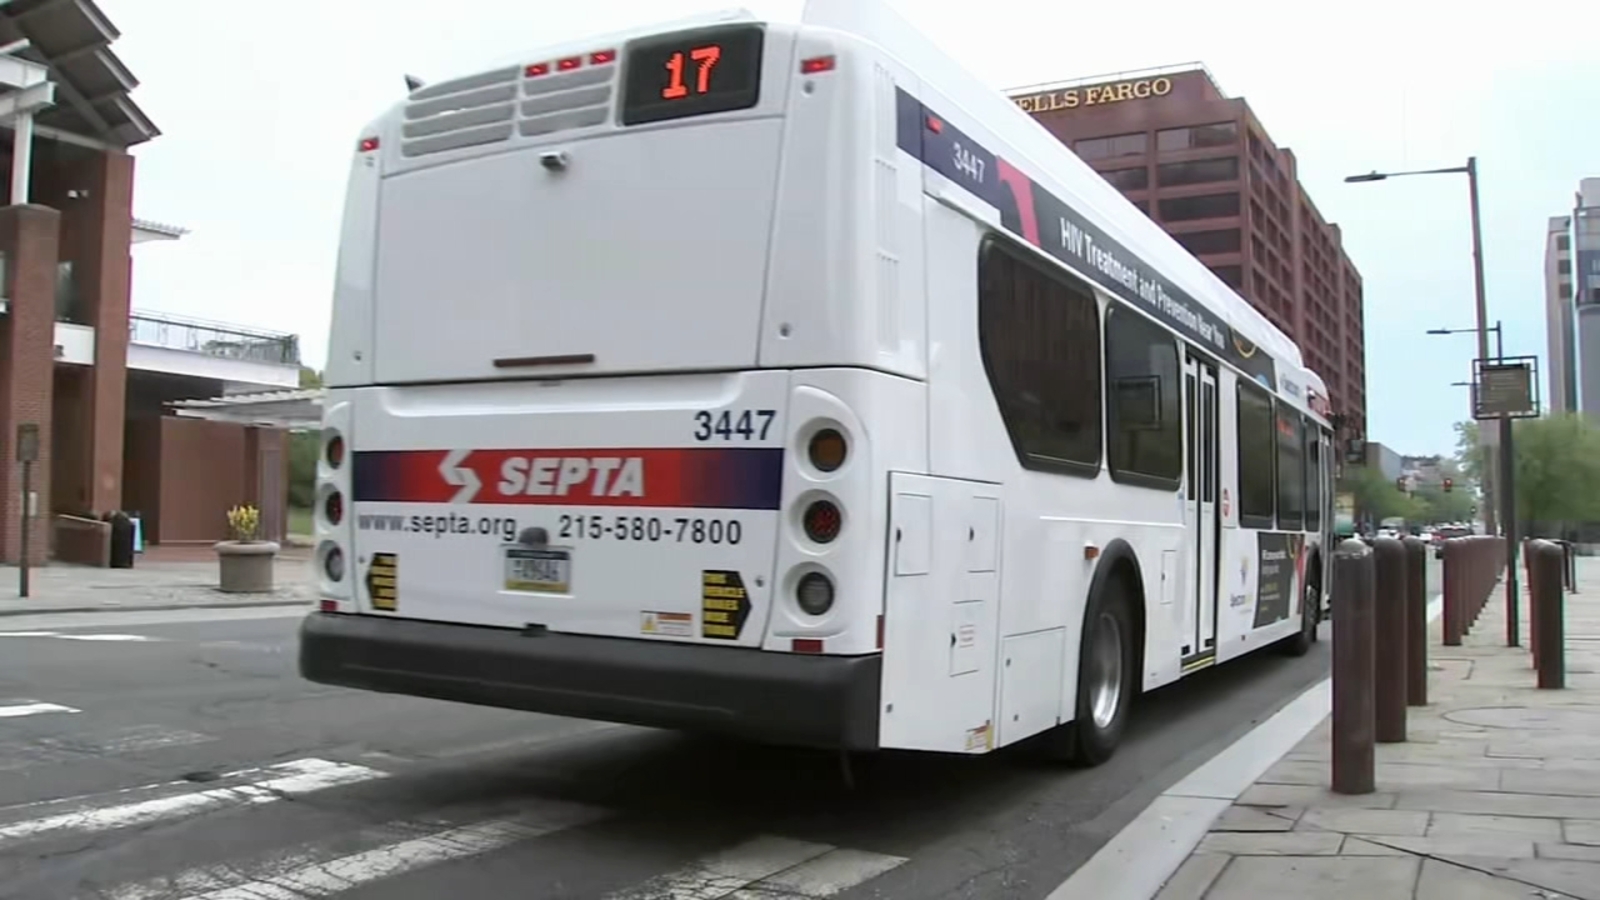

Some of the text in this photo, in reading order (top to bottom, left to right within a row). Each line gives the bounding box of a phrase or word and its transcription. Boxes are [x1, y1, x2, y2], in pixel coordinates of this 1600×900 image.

[662, 45, 721, 99] 17
[1014, 78, 1172, 113] ELLS FARGO
[953, 141, 985, 183] 3447
[1060, 217, 1083, 258] HIV
[1084, 232, 1138, 294] Treatment
[1139, 278, 1156, 307] and
[1157, 284, 1199, 332] Prevention
[694, 410, 777, 441] 3447
[497, 456, 646, 497] SEPTA
[358, 512, 742, 545] www.septa.org 215-580-7800
